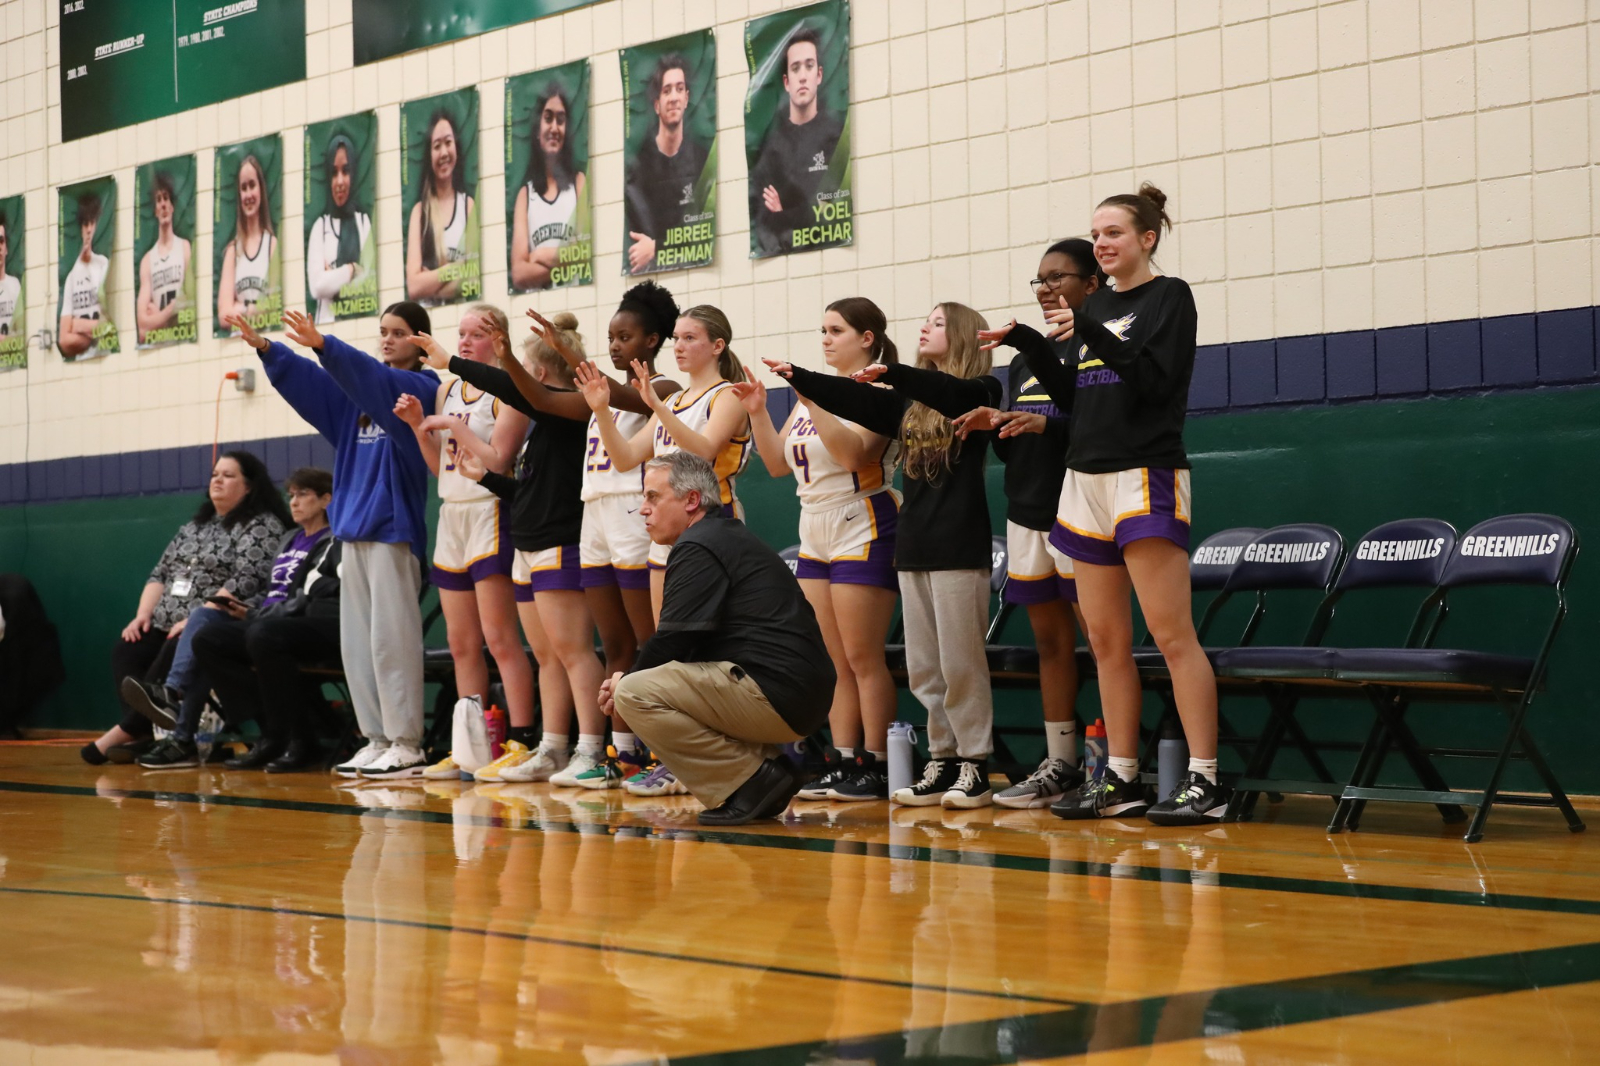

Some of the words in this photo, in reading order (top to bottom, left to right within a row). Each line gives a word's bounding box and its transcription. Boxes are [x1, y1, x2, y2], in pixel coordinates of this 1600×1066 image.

[203, 7, 223, 22] STATE
[94, 43, 113, 57] STATE
[816, 191, 833, 201] Class
[812, 201, 851, 223] YOEL
[663, 222, 714, 246] JIBREEL
[792, 222, 851, 248] BECHAR
[657, 242, 713, 267] REHMAN
[550, 262, 593, 284] GUPTA
[792, 443, 811, 484] 4
[1243, 541, 1331, 563] GREENHILLS
[1356, 537, 1445, 562] GREENHILLS
[1460, 533, 1560, 558] GREENHILLS
